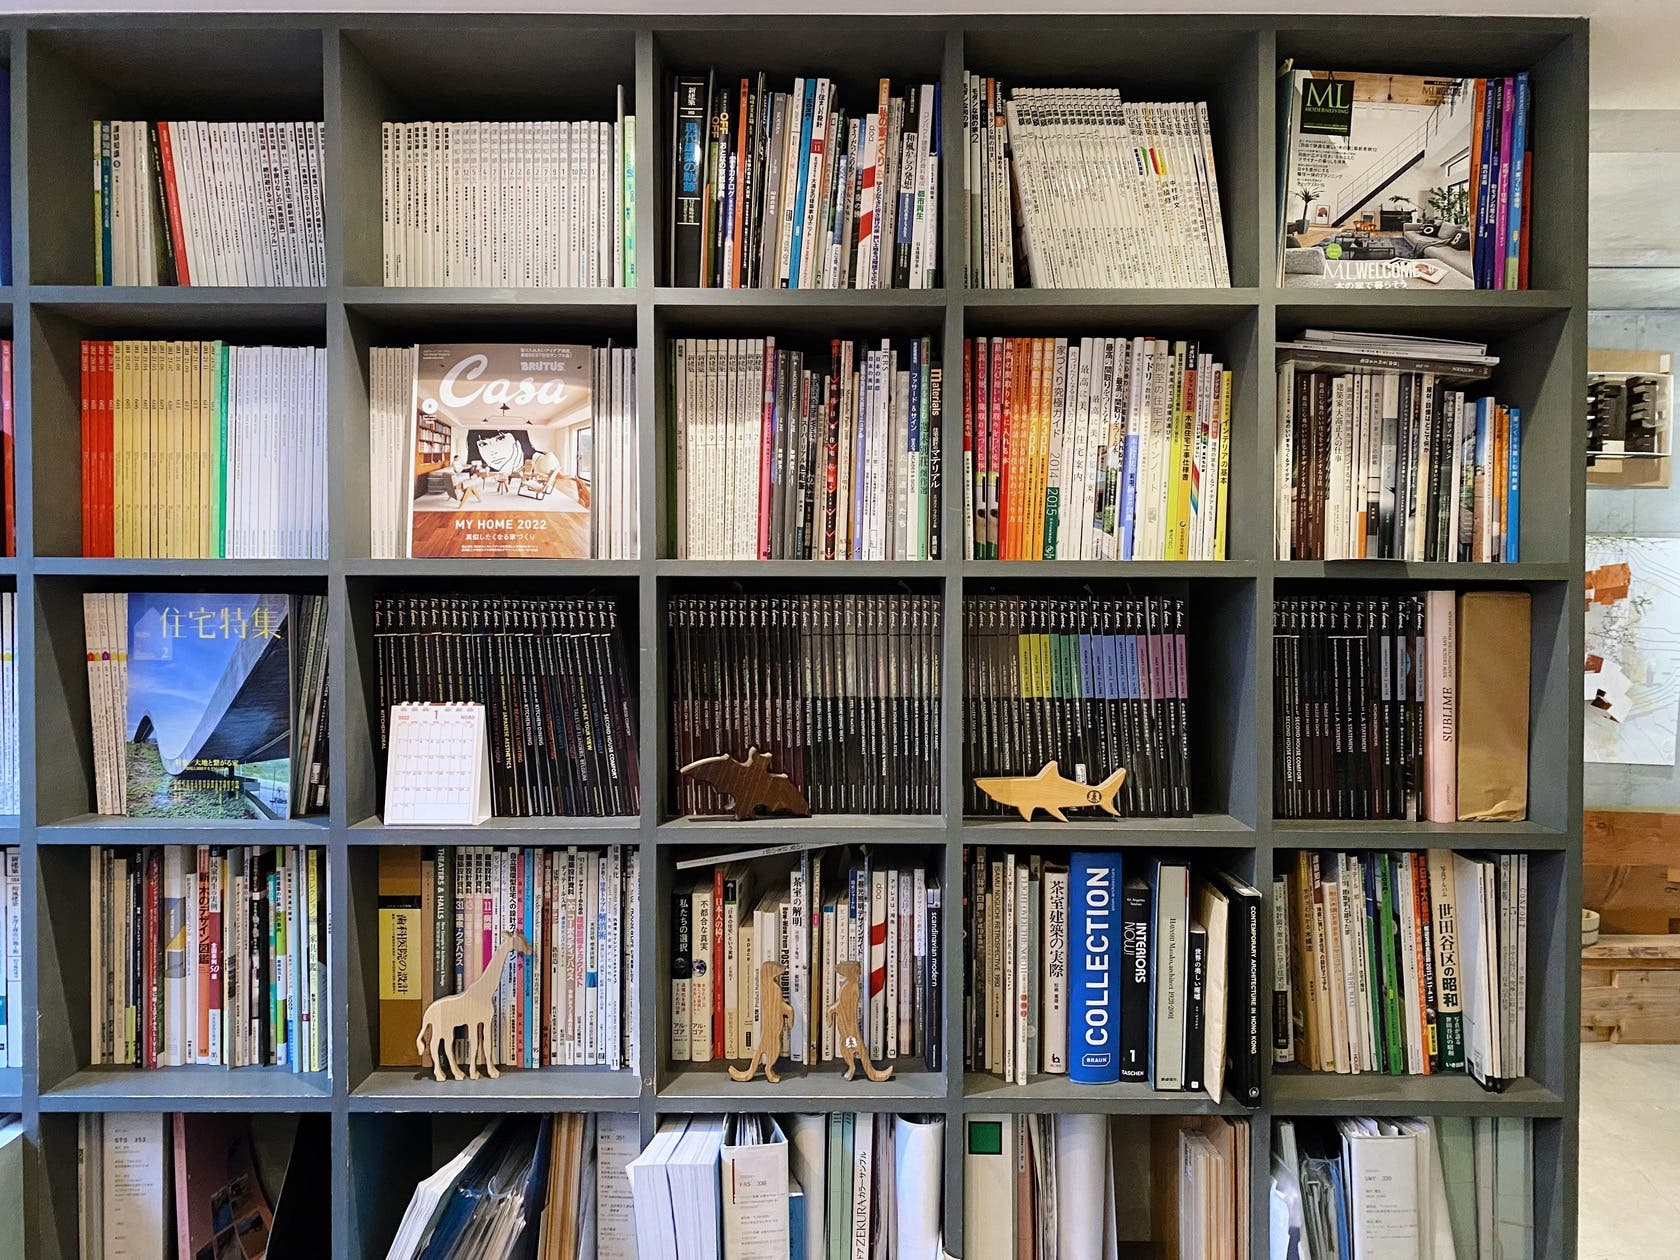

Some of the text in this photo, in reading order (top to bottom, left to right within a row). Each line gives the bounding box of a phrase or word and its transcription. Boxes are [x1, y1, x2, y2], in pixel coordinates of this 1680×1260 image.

[1305, 82, 1350, 108] ML
[711, 116, 720, 138] OFF
[720, 112, 729, 135] OFF
[903, 132, 916, 190] 和風からの発想
[439, 354, 568, 408] Casa
[521, 361, 566, 372] BRUTUS
[1053, 345, 1066, 437] 家づくり究極ガイド
[930, 450, 941, 489] マテリアル
[1182, 414, 1194, 482] 木造住宅工事仕様書
[1220, 419, 1231, 485] インテリアの基本
[455, 519, 547, 530] MY HOME 2022
[465, 533, 536, 541] 真似したくなる家づくり
[160, 607, 283, 640] 住宅特集
[1442, 687, 1453, 742] SUBLIME
[609, 753, 618, 779] COMFORT
[456, 901, 464, 910] 31
[680, 899, 688, 952] 私たちの選択
[700, 900, 709, 951] 不都合な真実
[1049, 880, 1064, 978] 茶室建築の実際
[396, 914, 408, 994] 歯科医院の設計
[1085, 868, 1110, 1046] COLLECTION
[1135, 922, 1147, 984] INTERIORS
[1438, 903, 1458, 1008] 世田谷区の昭和
[1250, 1006, 1257, 1014] IN
[1121, 1069, 1144, 1077] TASCHEN
[1129, 1050, 1136, 1063] 1
